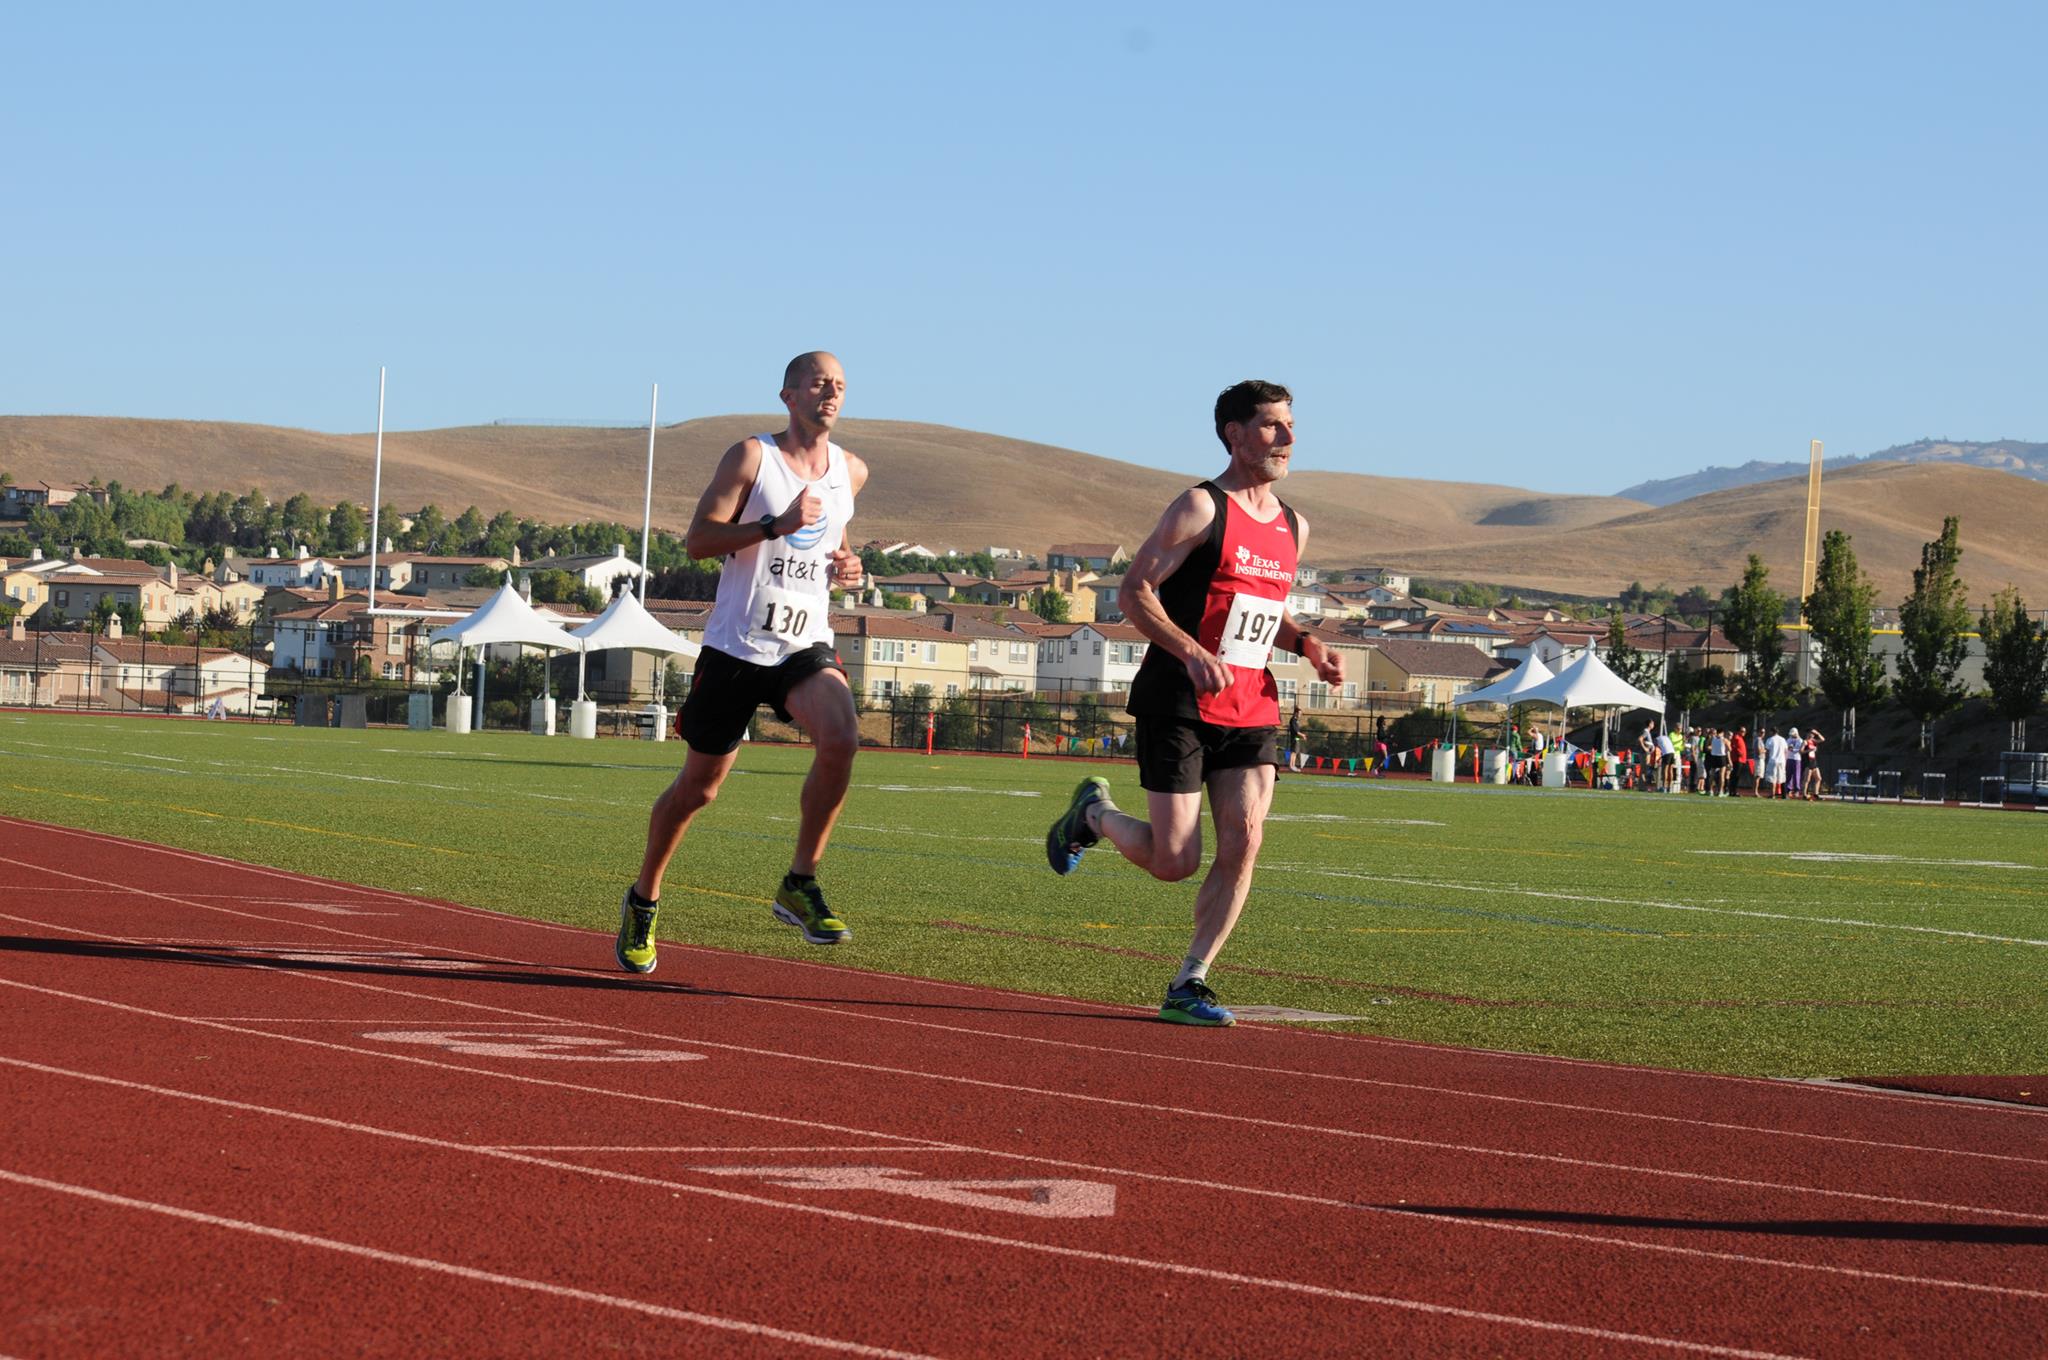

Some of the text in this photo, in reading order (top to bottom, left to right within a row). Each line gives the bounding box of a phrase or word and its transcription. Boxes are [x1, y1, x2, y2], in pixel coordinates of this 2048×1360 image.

[770, 556, 819, 581] at&t
[1235, 562, 1293, 583] INSTRUMENTS
[761, 602, 808, 637] 130
[1234, 610, 1278, 645] 197
[360, 1031, 709, 1062] 3
[684, 1166, 1116, 1218] 4
